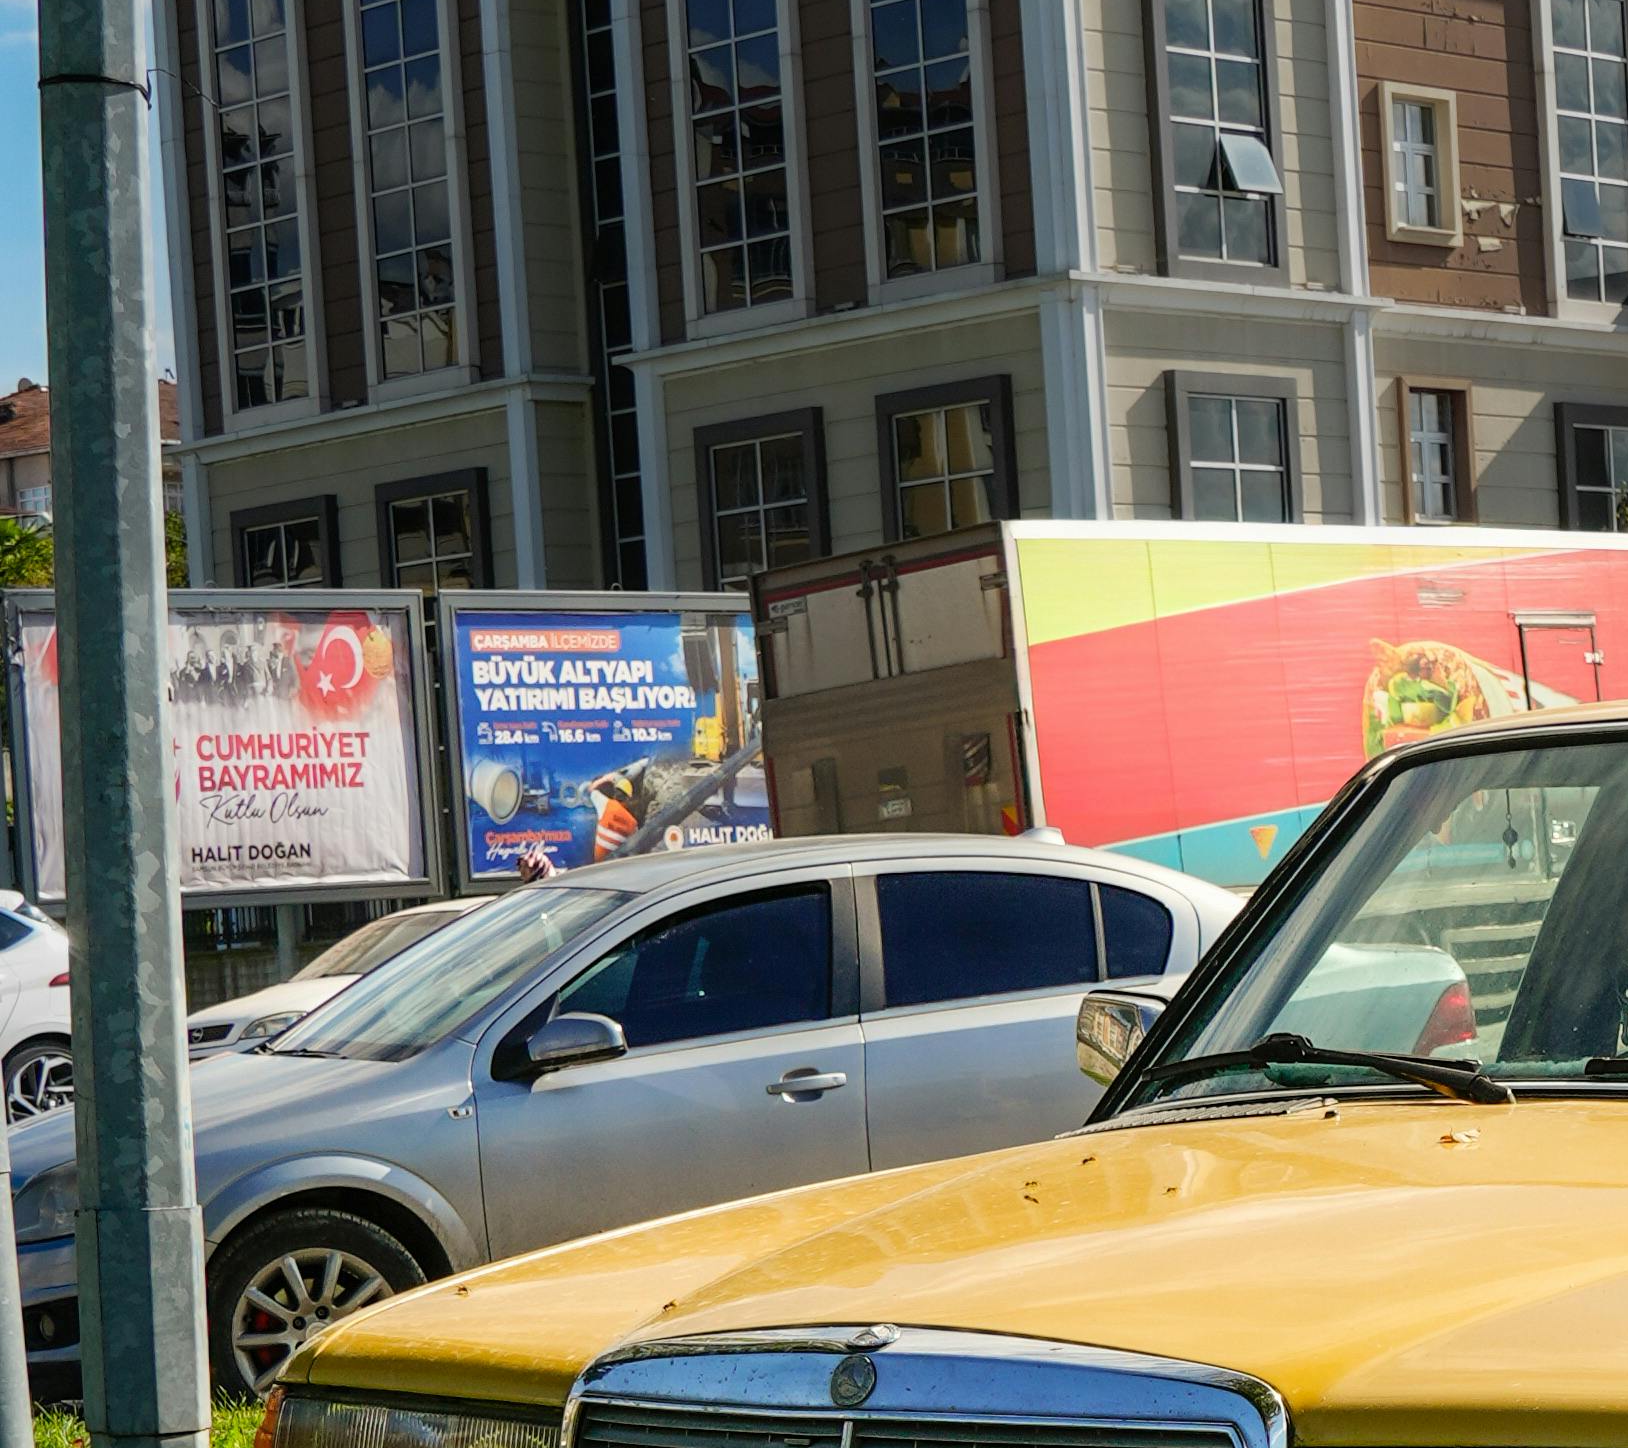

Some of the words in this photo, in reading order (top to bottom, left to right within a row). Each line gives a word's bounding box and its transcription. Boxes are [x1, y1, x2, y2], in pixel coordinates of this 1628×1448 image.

[474, 634, 549, 651] ÇARŞAMBA
[551, 632, 618, 649] İLÇEMİZDE
[472, 655, 556, 685] BÜYÜK
[559, 660, 654, 684] ALTYAPI
[474, 687, 576, 712] YATIRIMI
[578, 685, 698, 713] BAŞLIYOR!
[196, 726, 370, 761] CUMHURİYET
[199, 763, 365, 792] BAYRAMIMIZ
[199, 794, 265, 828] Kutlu
[270, 792, 328, 823] Olsun
[248, 841, 311, 861] DOĞAN
